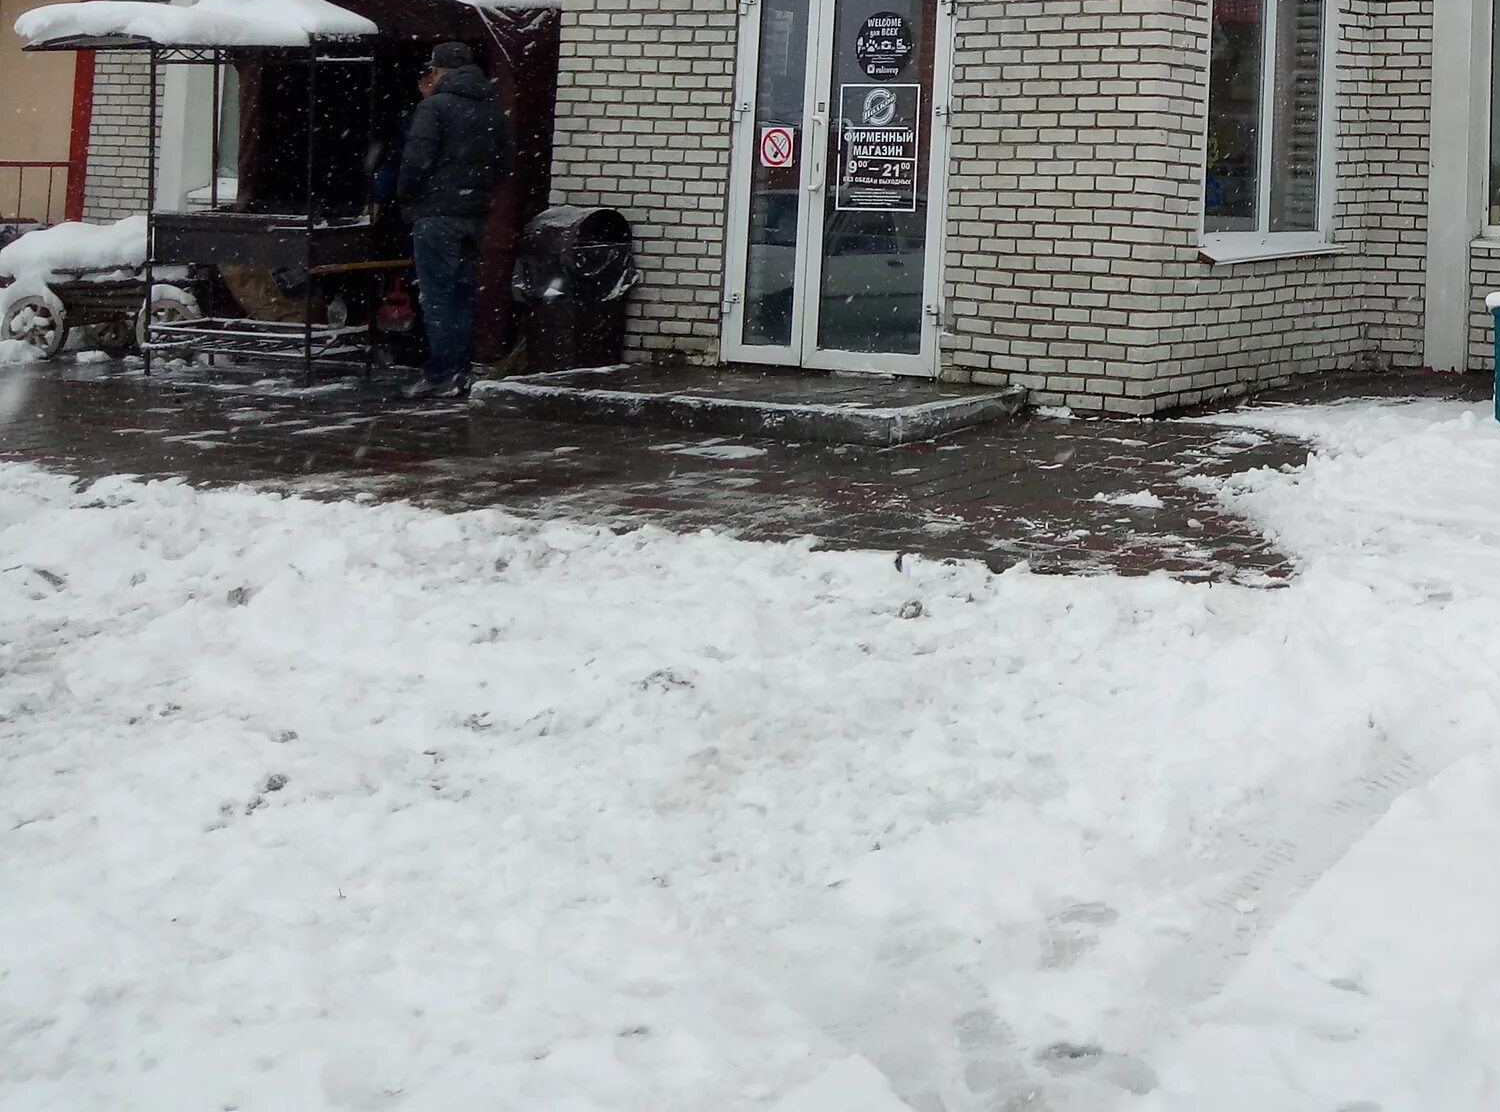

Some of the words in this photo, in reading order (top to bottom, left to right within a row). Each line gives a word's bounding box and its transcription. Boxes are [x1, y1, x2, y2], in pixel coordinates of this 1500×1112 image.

[867, 17, 903, 28] WELCOME
[881, 28, 899, 36] ВСЕХ
[844, 130, 914, 143] ФИРМЕННЫЙ
[853, 145, 903, 157] МАГАЗИН
